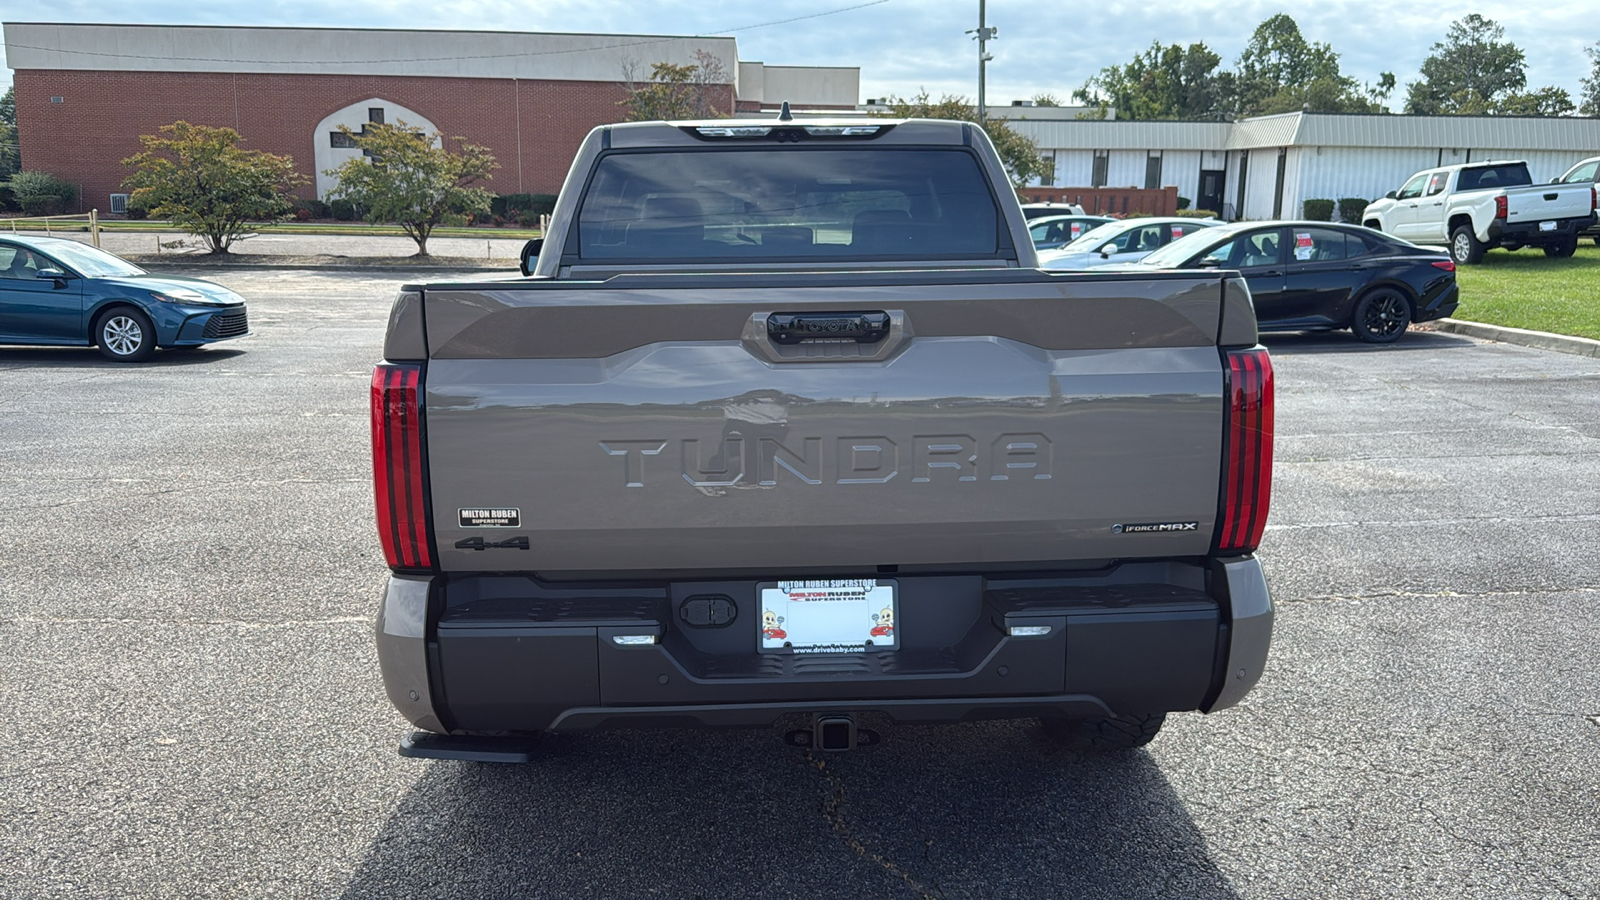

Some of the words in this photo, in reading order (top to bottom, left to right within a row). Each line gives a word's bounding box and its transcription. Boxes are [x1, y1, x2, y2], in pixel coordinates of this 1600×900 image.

[801, 320, 857, 332] TOYOTA
[599, 433, 1053, 488] TUNDRA
[462, 510, 490, 518] MILTON
[491, 510, 516, 518] RUBEN
[778, 580, 804, 588] MILTON
[830, 580, 877, 588] SUPERSTORE
